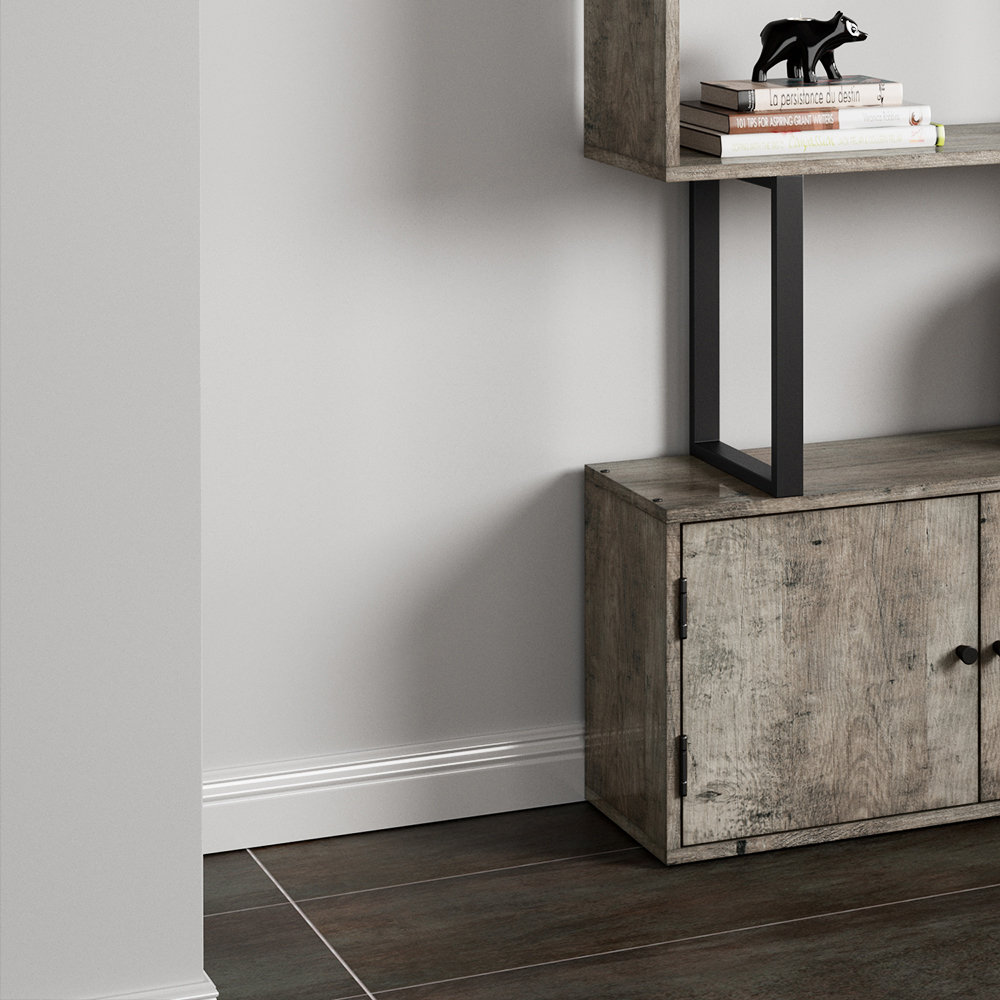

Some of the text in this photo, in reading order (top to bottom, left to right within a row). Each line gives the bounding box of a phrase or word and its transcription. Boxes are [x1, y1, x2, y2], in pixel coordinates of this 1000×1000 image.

[769, 91, 778, 107] La
[826, 86, 836, 104] du
[838, 86, 861, 103] destin
[736, 113, 834, 129] 101 TIPS FOR ASPIRING GRANT WRITERS
